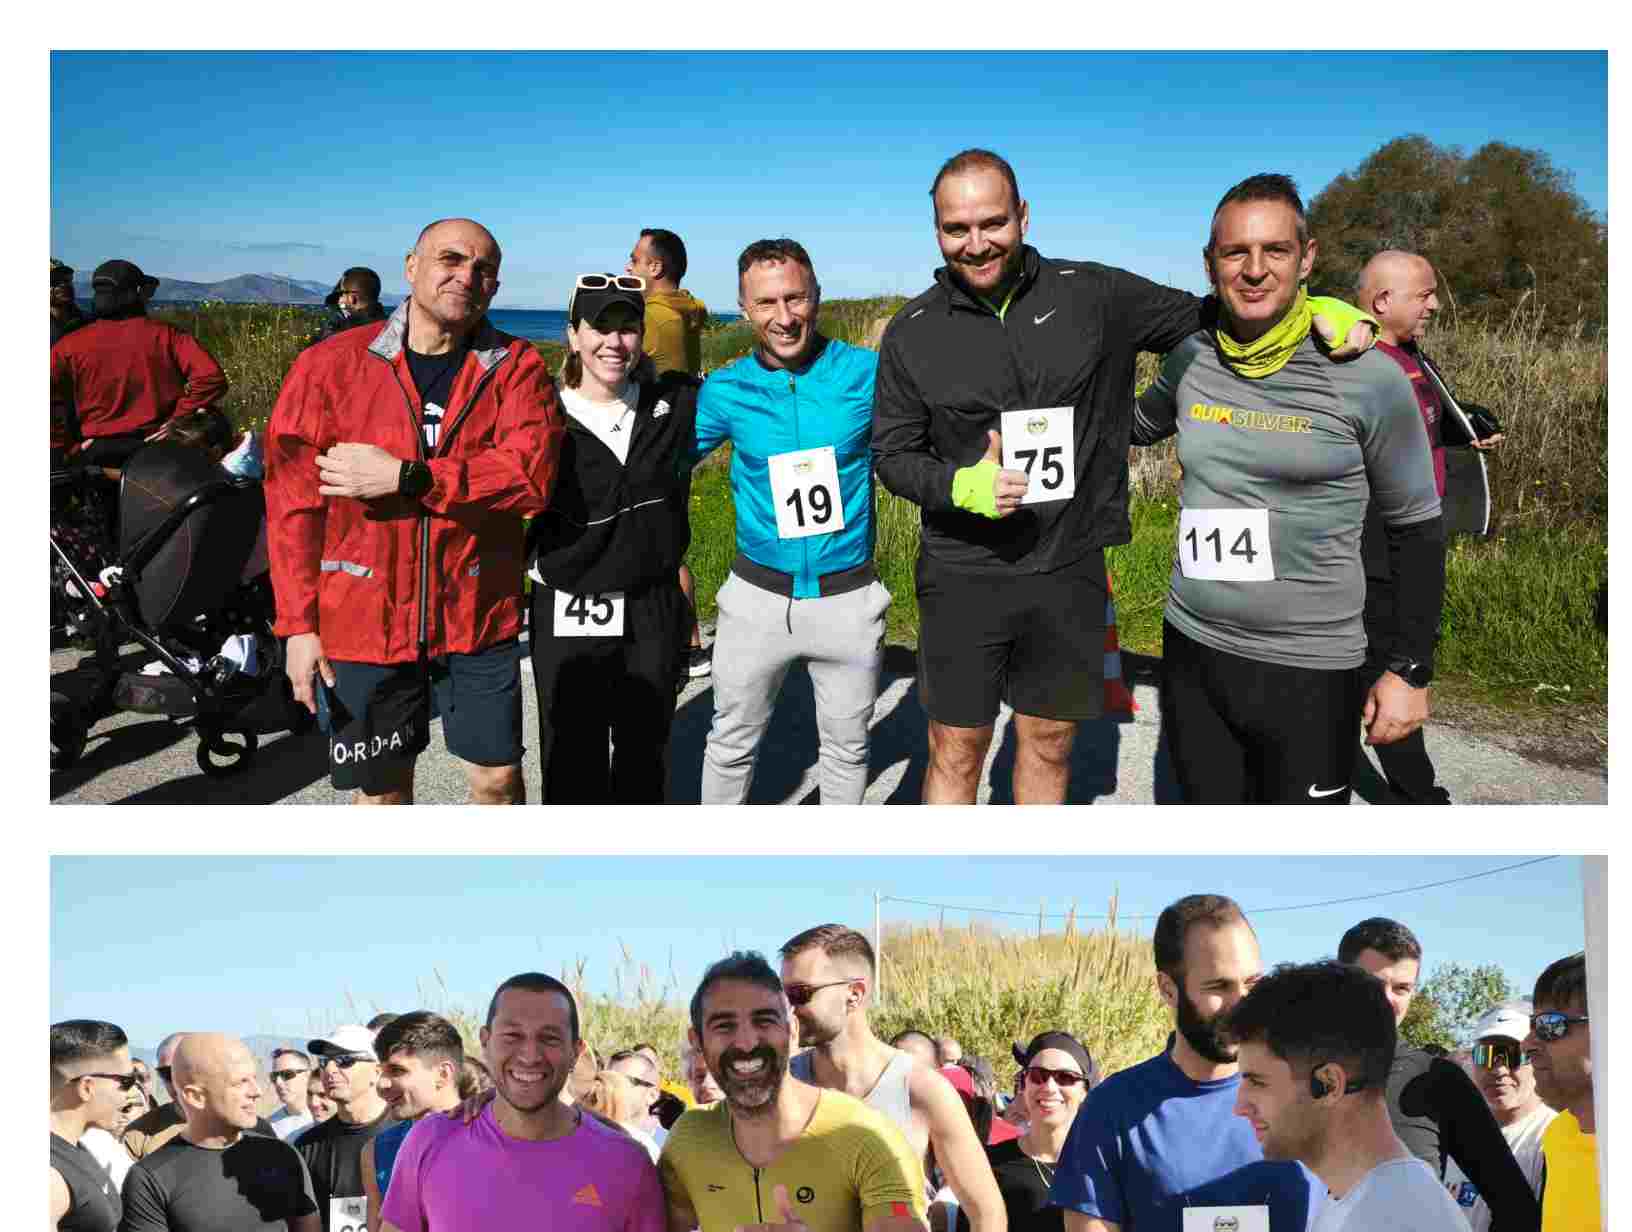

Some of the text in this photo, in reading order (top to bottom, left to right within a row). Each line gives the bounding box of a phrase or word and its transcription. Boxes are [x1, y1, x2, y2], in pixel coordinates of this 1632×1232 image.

[1190, 403, 1313, 433] QUIKSILVER
[1014, 445, 1065, 490] 75
[786, 484, 832, 527] 19
[1185, 527, 1259, 563] 114
[564, 592, 615, 625] 45
